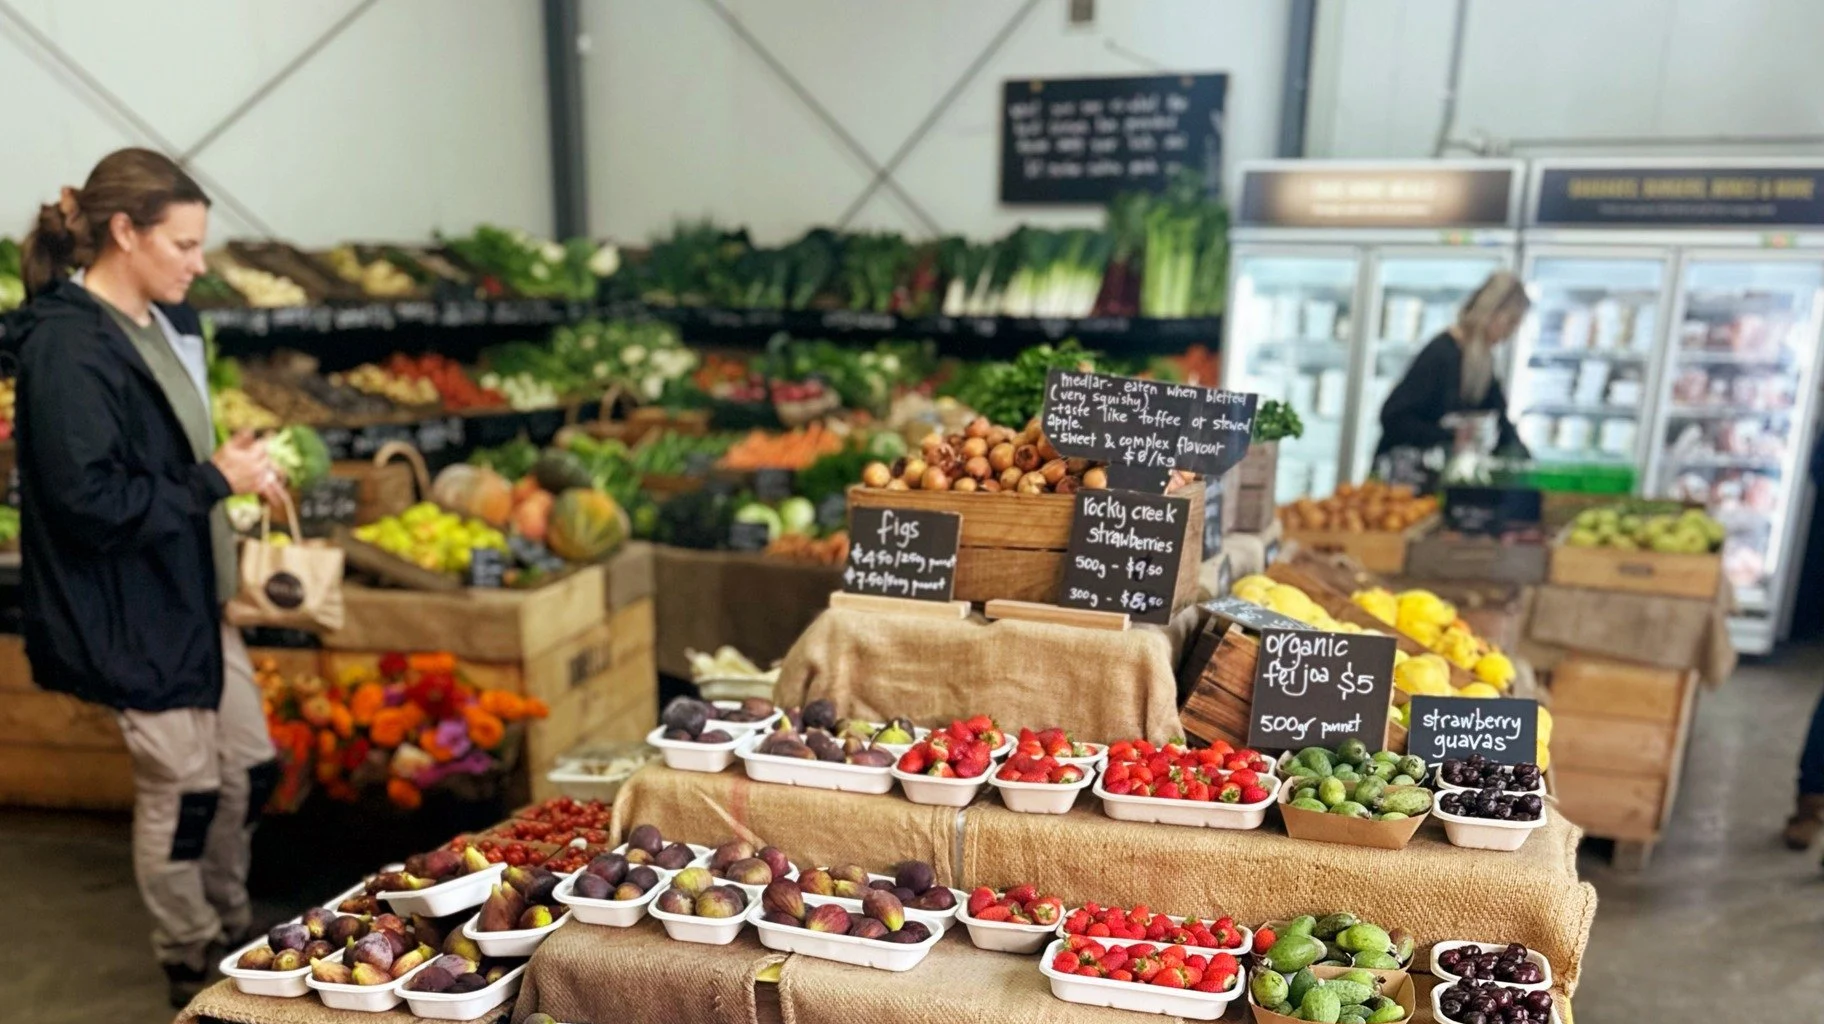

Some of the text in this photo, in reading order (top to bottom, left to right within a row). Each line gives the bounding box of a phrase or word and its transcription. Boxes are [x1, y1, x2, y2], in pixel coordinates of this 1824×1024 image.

[1124, 381, 1158, 397] eaten
[1167, 386, 1197, 399] when
[1206, 389, 1246, 406] bletted
[1097, 405, 1128, 422] like
[1138, 409, 1181, 428] toffee
[1192, 416, 1207, 429] or
[1213, 416, 1250, 433] stewed
[1060, 432, 1097, 447] sweet
[1104, 433, 1116, 448] &
[1119, 433, 1169, 455] complex
[1176, 437, 1225, 455] flavour
[1083, 496, 1177, 528] rocky creek
[877, 509, 919, 548] figs
[1086, 522, 1173, 553] strawberries
[1075, 555, 1106, 578] 500g
[1069, 587, 1099, 607] 300g
[1266, 632, 1349, 671] organic
[1263, 658, 1374, 700] feijoa $5
[1260, 713, 1362, 740] 500gr punnet
[1423, 707, 1521, 740] strawberry
[1432, 733, 1507, 758] guavas
